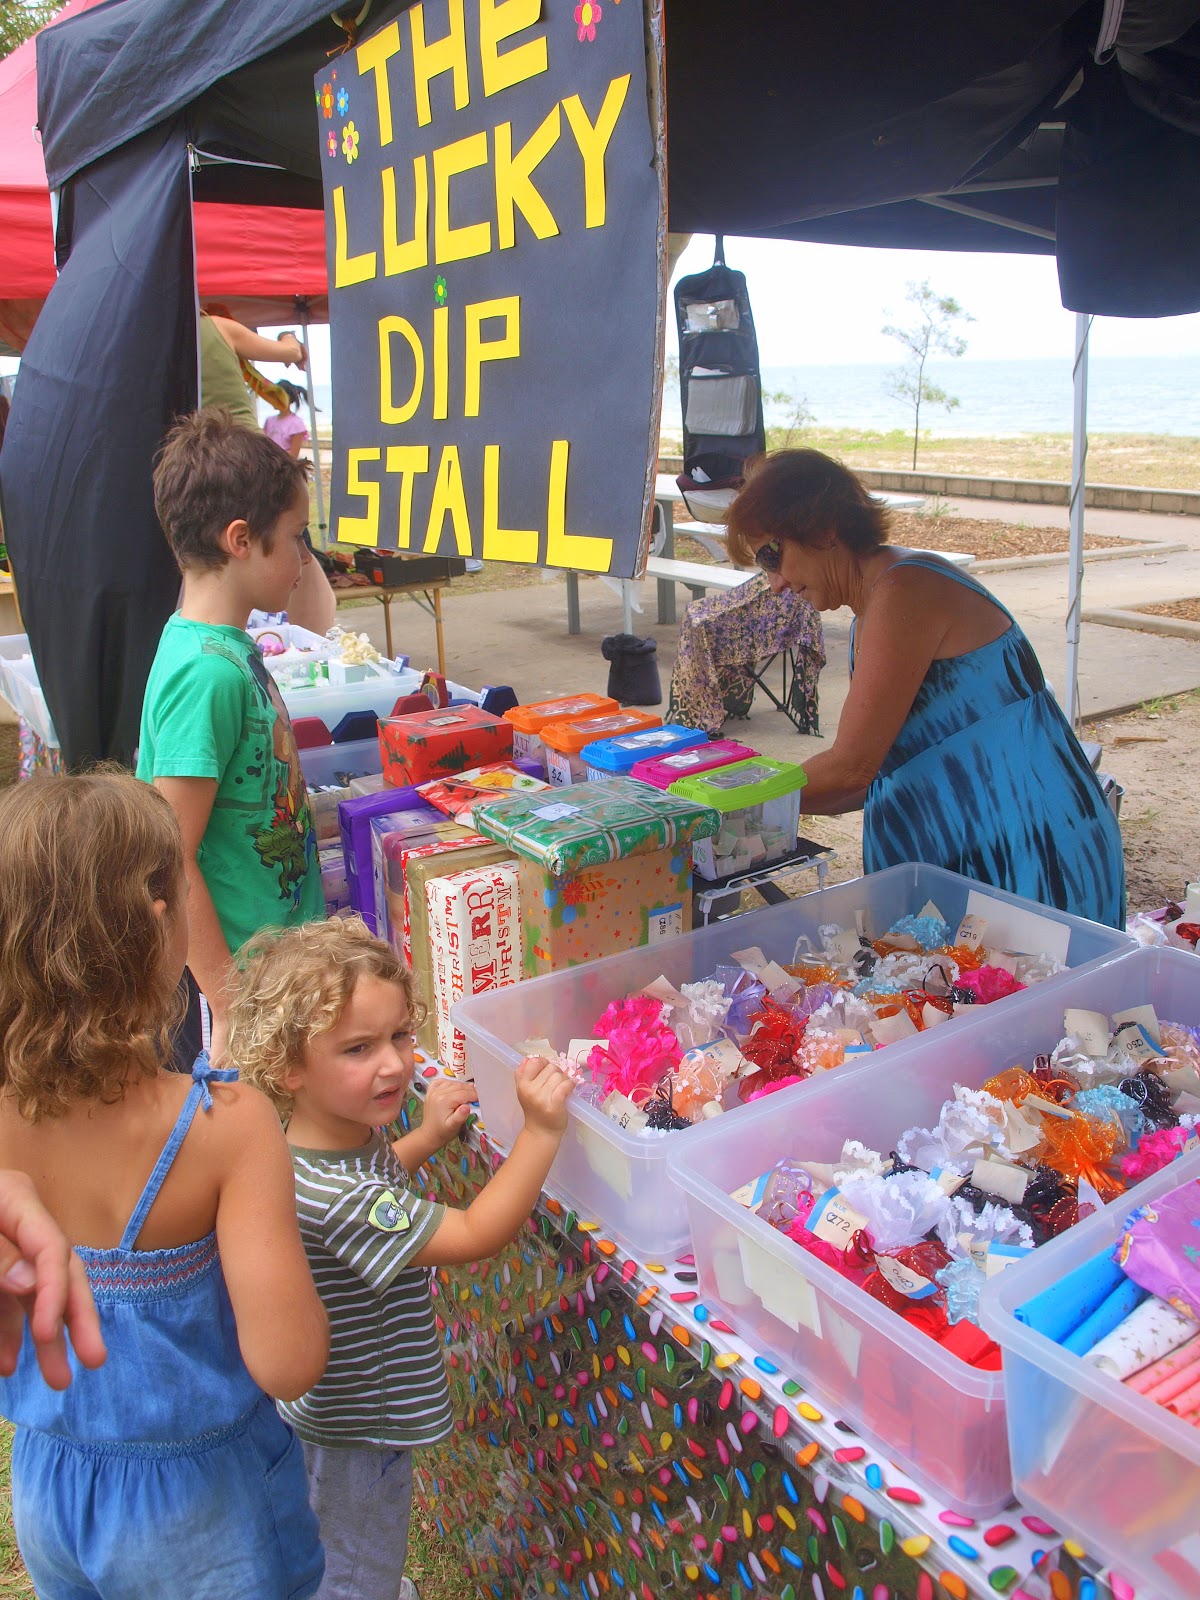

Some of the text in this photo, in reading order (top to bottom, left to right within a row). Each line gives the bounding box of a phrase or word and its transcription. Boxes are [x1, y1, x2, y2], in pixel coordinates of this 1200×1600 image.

[356, 0, 548, 147] THE
[333, 73, 631, 288] LUCKY
[377, 295, 520, 424] DIP
[336, 440, 613, 573] STALL
[452, 1027, 466, 1077] MERR
